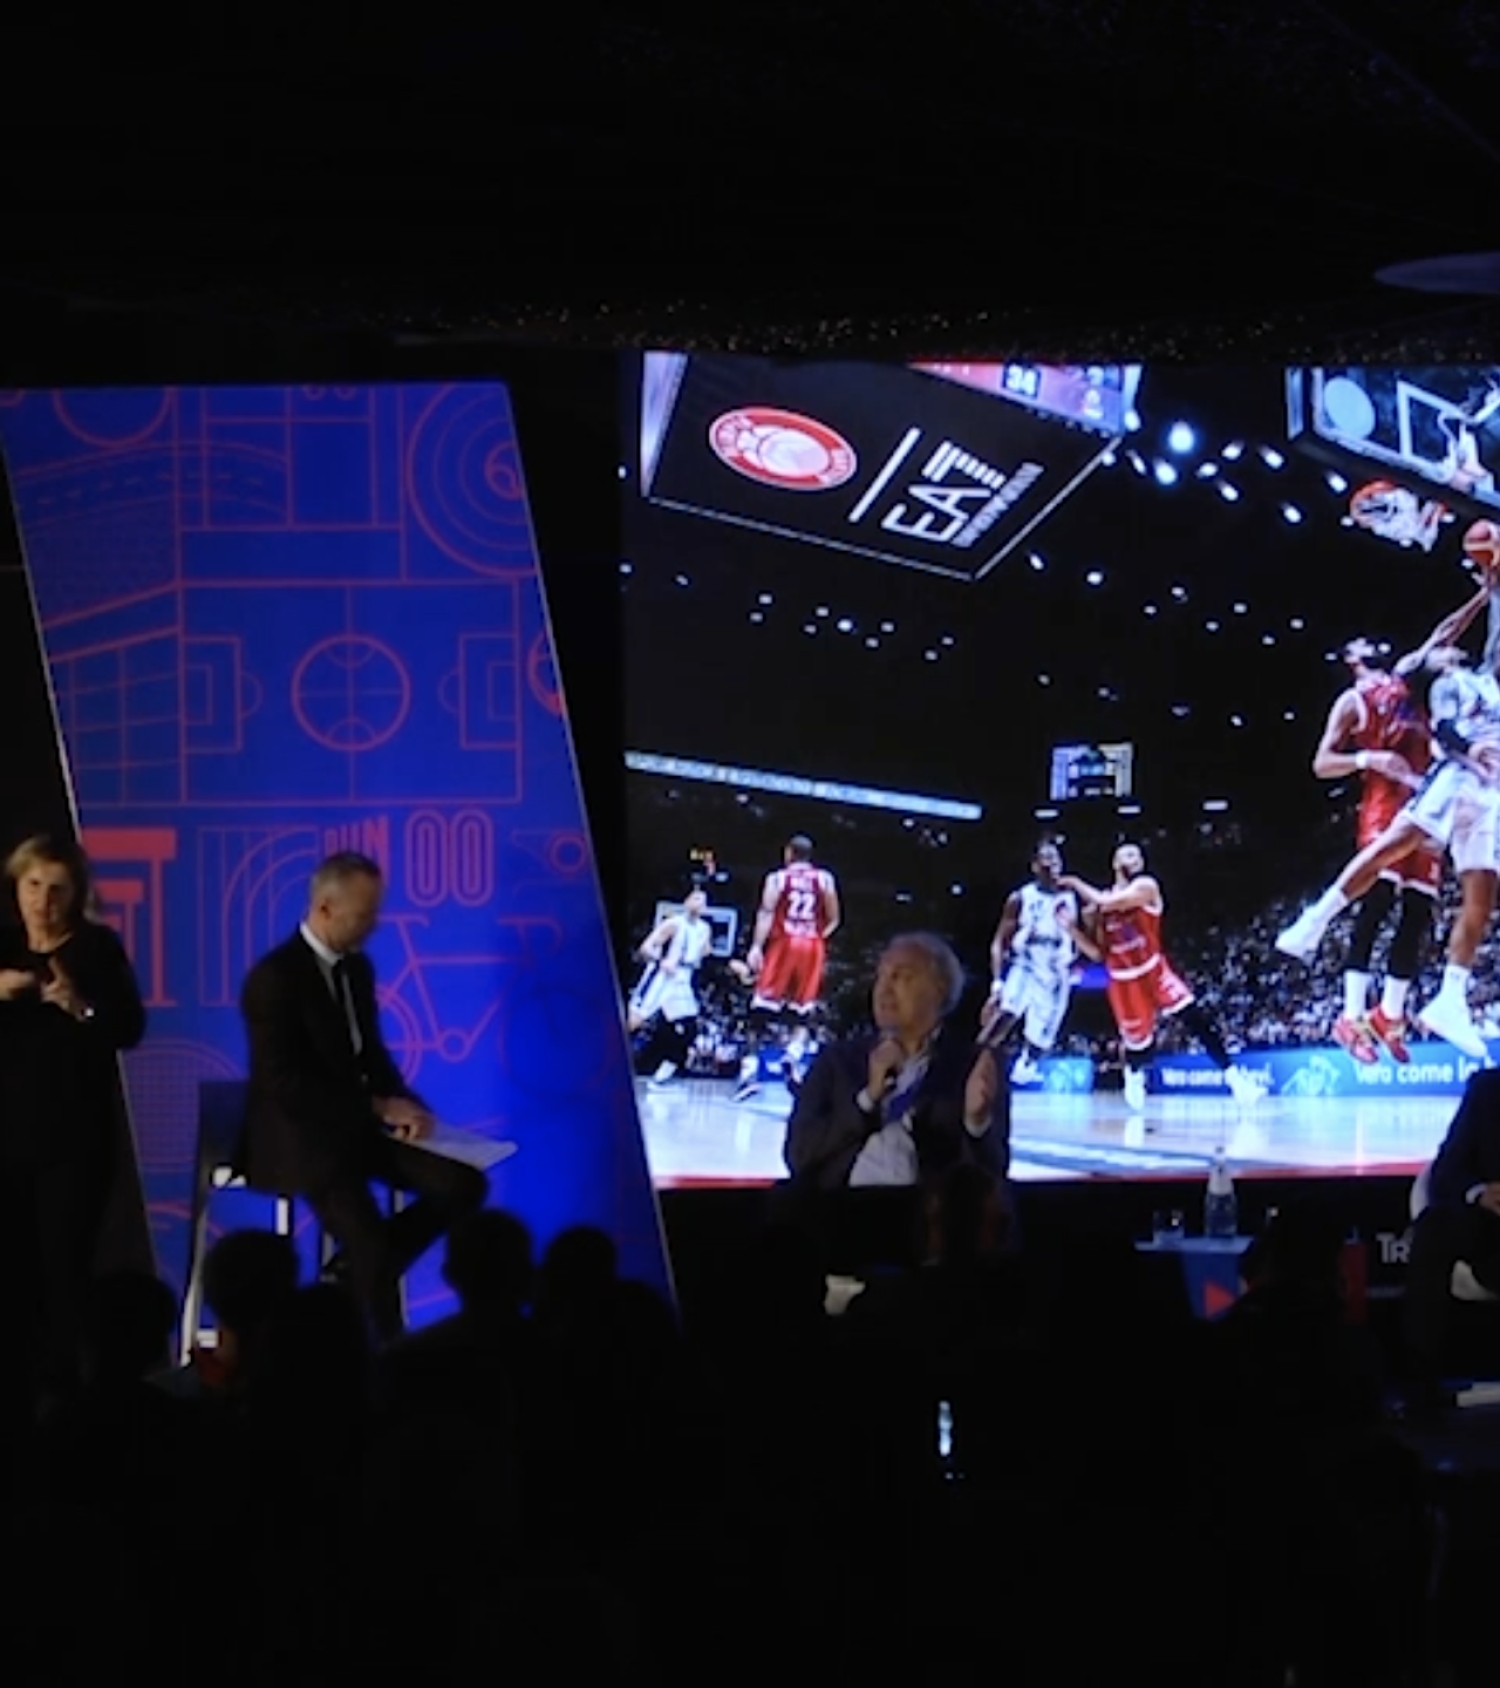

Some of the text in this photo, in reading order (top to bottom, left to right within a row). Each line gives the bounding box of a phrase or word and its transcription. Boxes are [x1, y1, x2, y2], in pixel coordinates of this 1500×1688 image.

[787, 889, 816, 920] 22
[1397, 1063, 1454, 1084] come
[1375, 1231, 1411, 1263] TR
